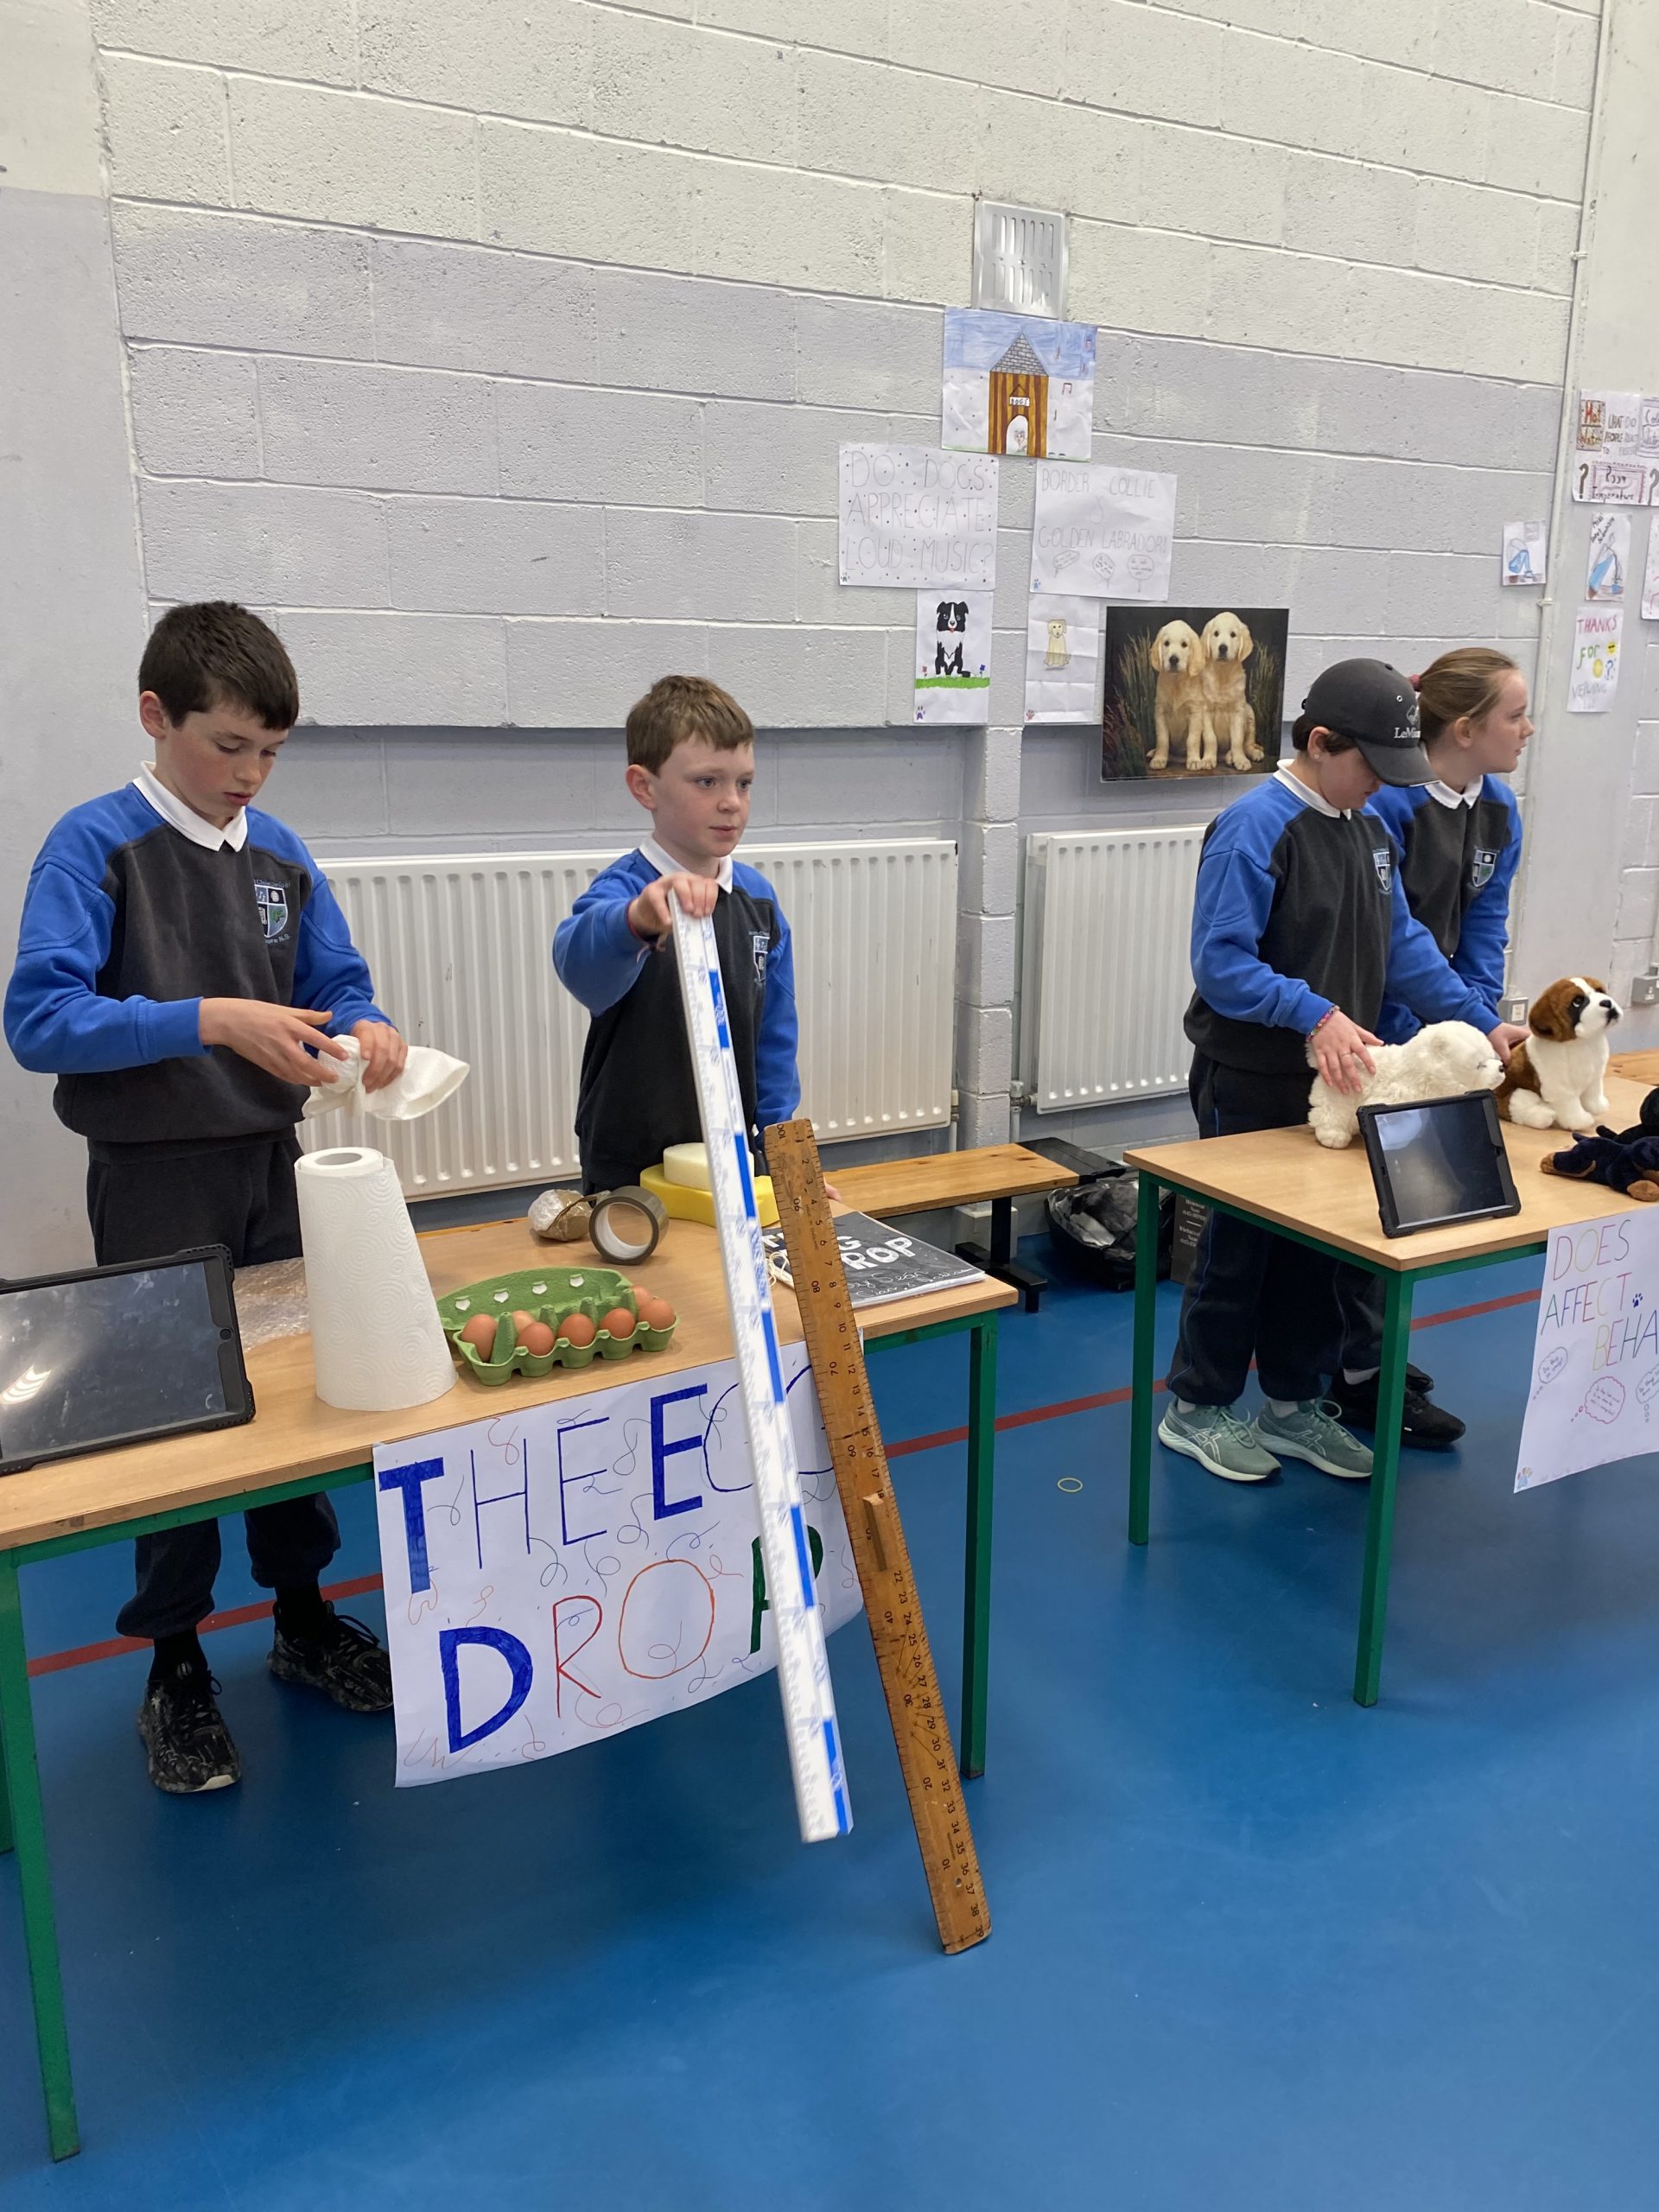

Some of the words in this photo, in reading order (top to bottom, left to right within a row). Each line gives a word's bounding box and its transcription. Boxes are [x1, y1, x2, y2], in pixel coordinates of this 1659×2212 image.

[849, 450, 895, 488] DO
[925, 457, 985, 491] DOGS
[1041, 467, 1090, 493] BORDER
[1109, 473, 1155, 499] COLLIE
[847, 492, 985, 532] APPRECIATE
[1038, 525, 1093, 549] GOLDEN
[845, 536, 904, 571] LOUD
[920, 538, 994, 574] MUSIC?
[1577, 615, 1617, 633] THANKS
[842, 1236, 916, 1269] ROP
[1553, 1219, 1631, 1281] DOES
[1541, 1272, 1632, 1336] AFFECT
[838, 1322, 847, 1333] 10
[842, 1343, 851, 1351] 11
[848, 1363, 856, 1375] 12
[852, 1384, 861, 1395] 13
[857, 1406, 865, 1416] 14
[867, 1446, 874, 1458] 16
[872, 1468, 880, 1478] 17
[777, 1124, 787, 1139] 100
[793, 1198, 801, 1211] 90
[811, 1281, 821, 1294] 80
[830, 1361, 839, 1376] 70
[847, 1445, 857, 1458] 60
[884, 1611, 893, 1624] 40
[904, 1694, 913, 1708] 30
[923, 1777, 932, 1791] 20
[942, 1859, 950, 1871] 10
[378, 1417, 610, 1594] THE
[894, 1571, 904, 1583] 22
[899, 1592, 908, 1605] 23
[908, 1633, 918, 1646] 25
[913, 1655, 922, 1668] 26
[918, 1675, 927, 1687] 27
[922, 1696, 931, 1709] 28
[927, 1717, 936, 1730] 29
[931, 1738, 942, 1751] 30
[937, 1759, 946, 1770] 31
[941, 1779, 951, 1792] 32
[946, 1801, 956, 1814] 33
[951, 1821, 961, 1834] 34
[956, 1841, 966, 1854] 35
[961, 1862, 970, 1876] 36
[965, 1883, 976, 1895] 37
[970, 1904, 980, 1917] 38
[976, 1925, 984, 1937] 39
